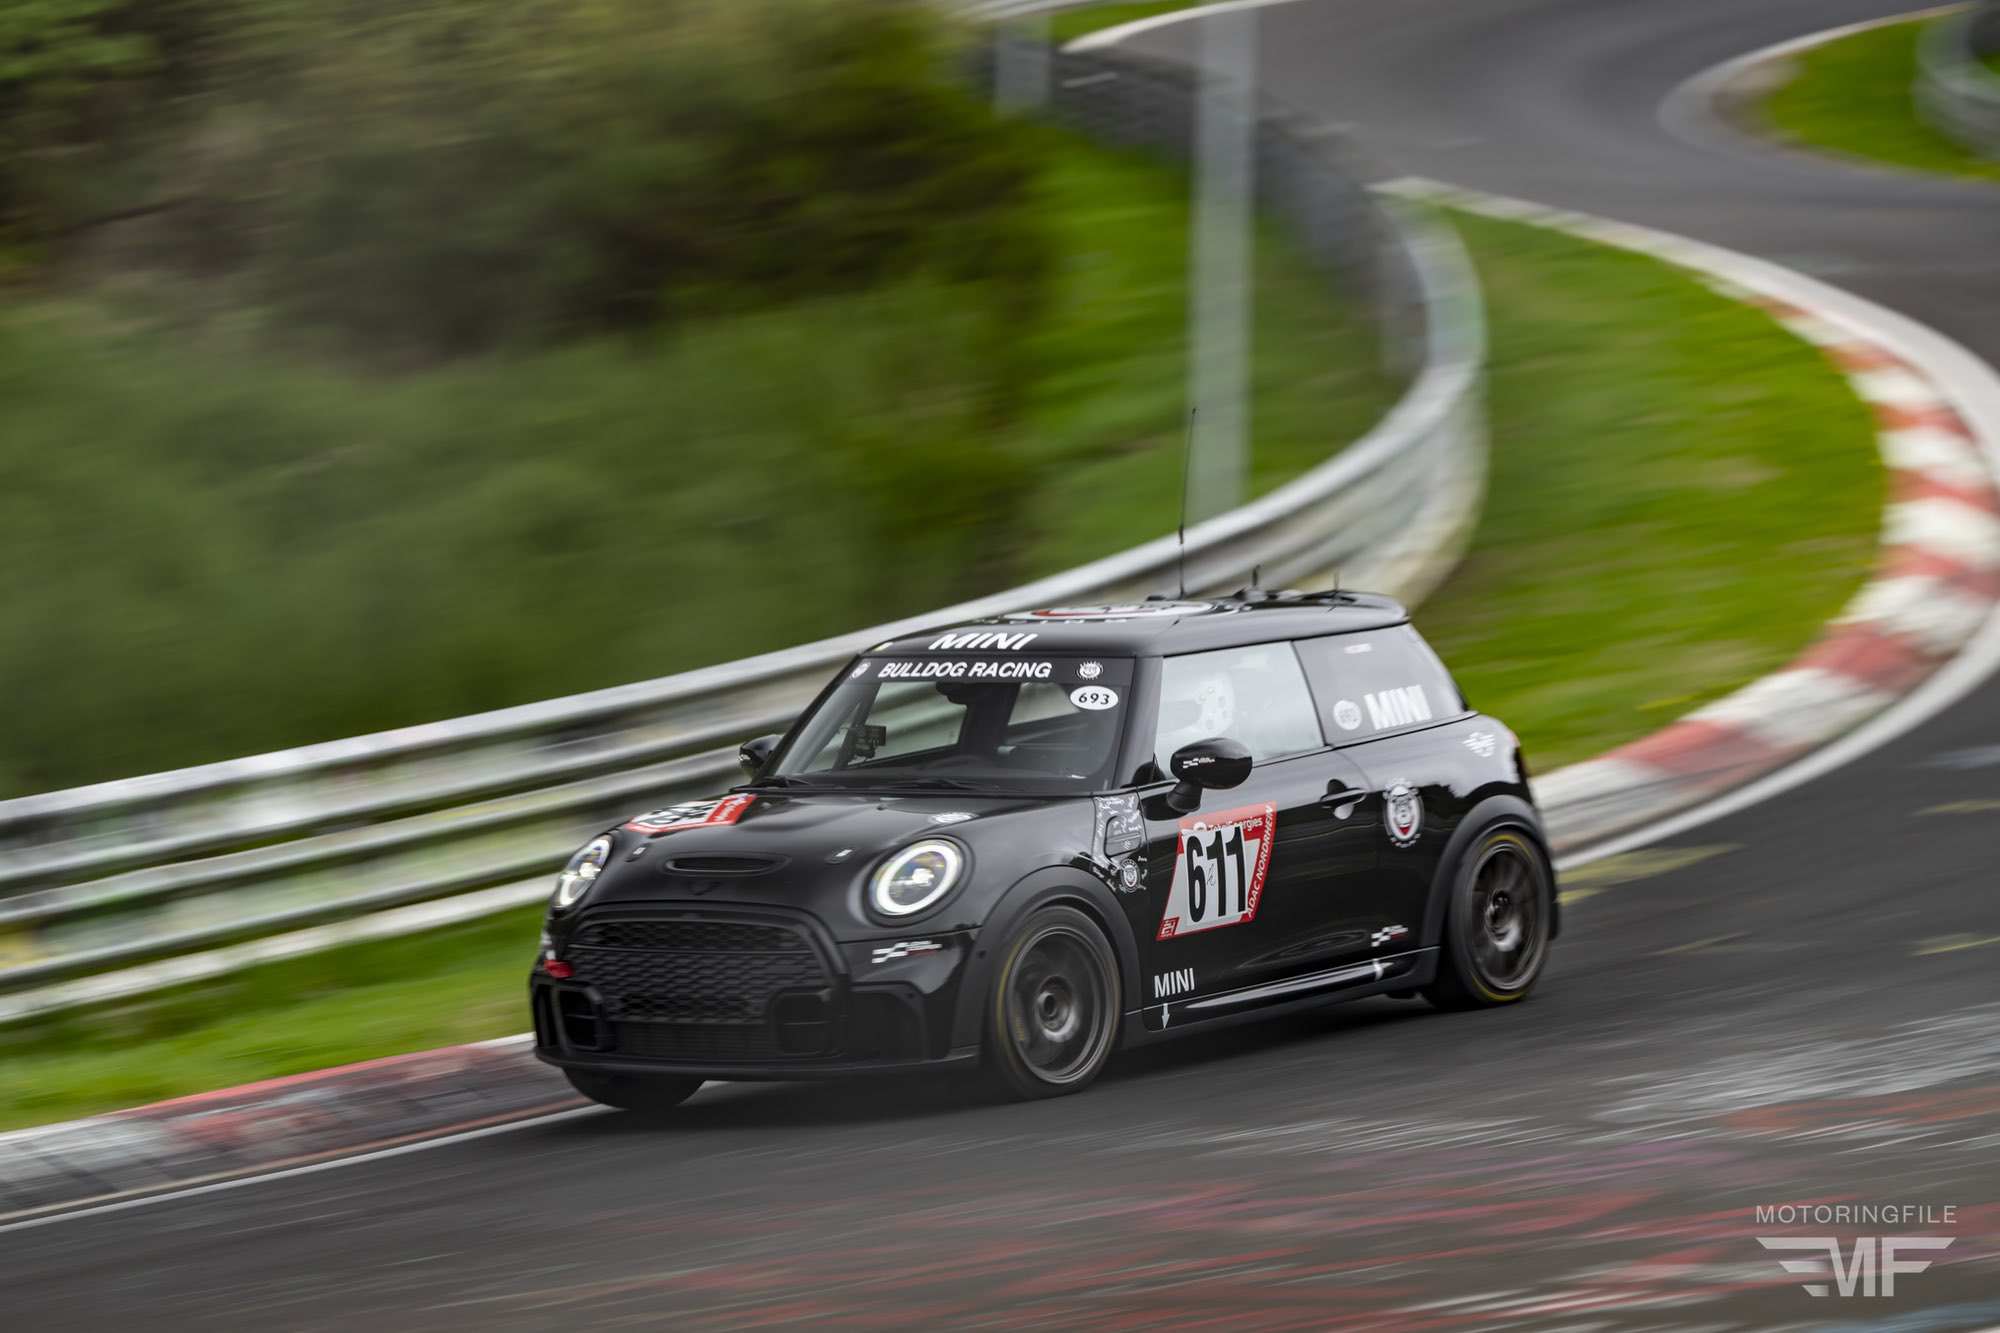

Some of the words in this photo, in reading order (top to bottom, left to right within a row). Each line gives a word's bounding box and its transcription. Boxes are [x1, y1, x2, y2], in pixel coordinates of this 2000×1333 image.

[928, 632, 1039, 650] MINI
[877, 661, 966, 678] BULLDOG
[968, 661, 1053, 679] RACING
[1078, 692, 1110, 705] 693
[1363, 684, 1433, 730] MINI
[1186, 826, 1247, 923] 611
[1247, 880, 1261, 918] ADAC
[1154, 967, 1196, 999] MINI
